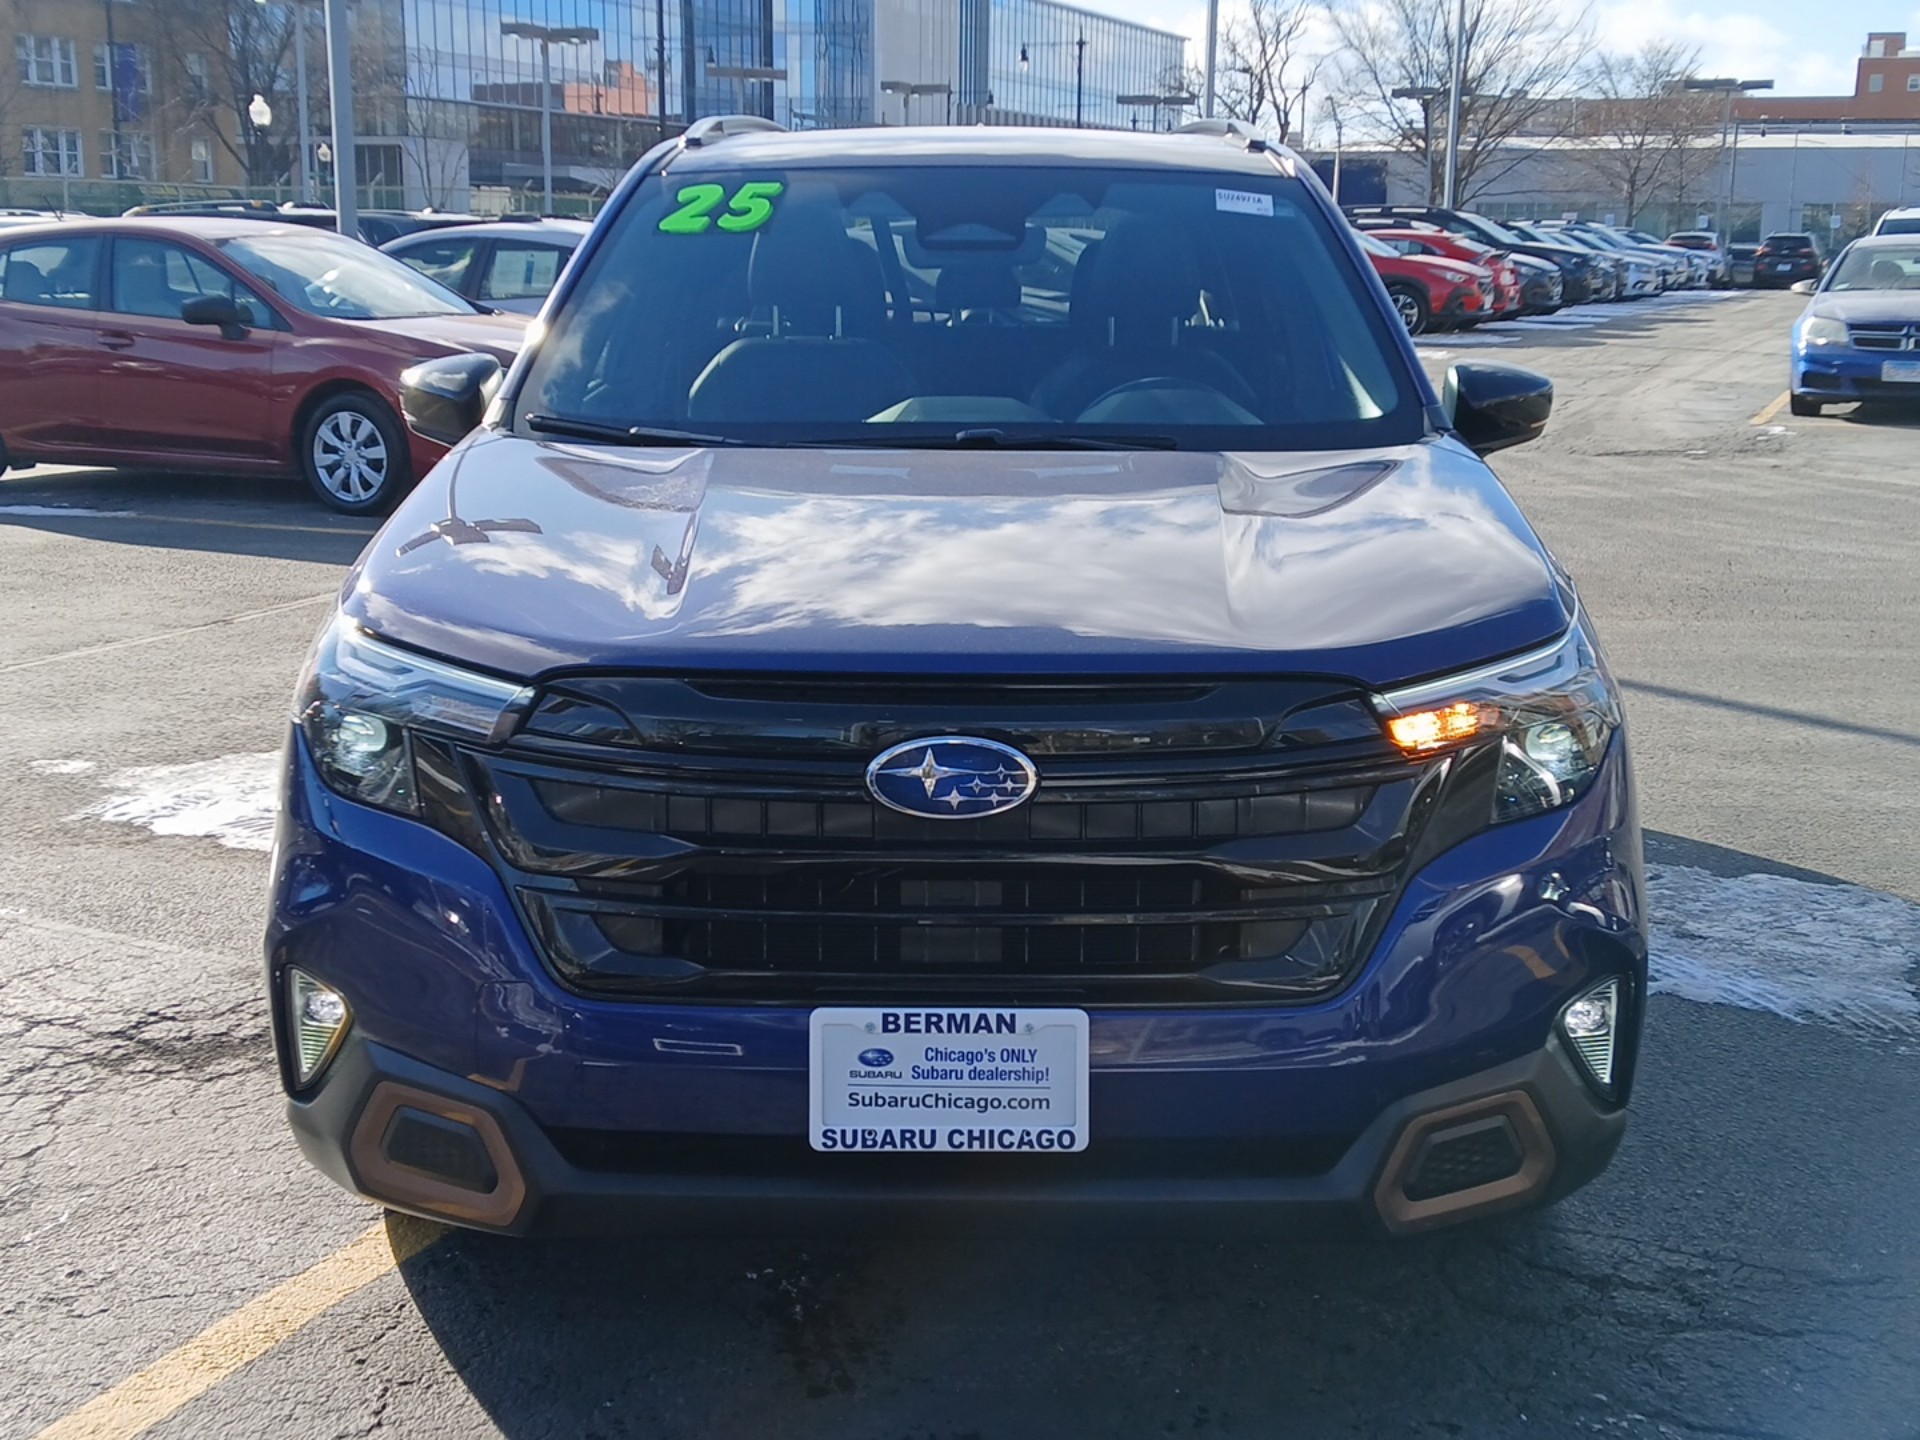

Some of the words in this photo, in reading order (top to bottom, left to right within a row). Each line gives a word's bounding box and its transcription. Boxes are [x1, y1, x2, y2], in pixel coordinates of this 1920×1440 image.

[659, 182, 783, 233] 25
[881, 1013, 1017, 1034] BERMAN
[925, 1047, 996, 1065] Chicago's
[1000, 1048, 1038, 1064] ONLY
[849, 1070, 902, 1079] SUBARU
[911, 1065, 964, 1081] Subaru
[968, 1066, 1050, 1084] dealership!
[848, 1092, 1050, 1113] SubaruChicago.com
[821, 1129, 937, 1149] SUBARU
[947, 1129, 1076, 1150] CHICAGO
